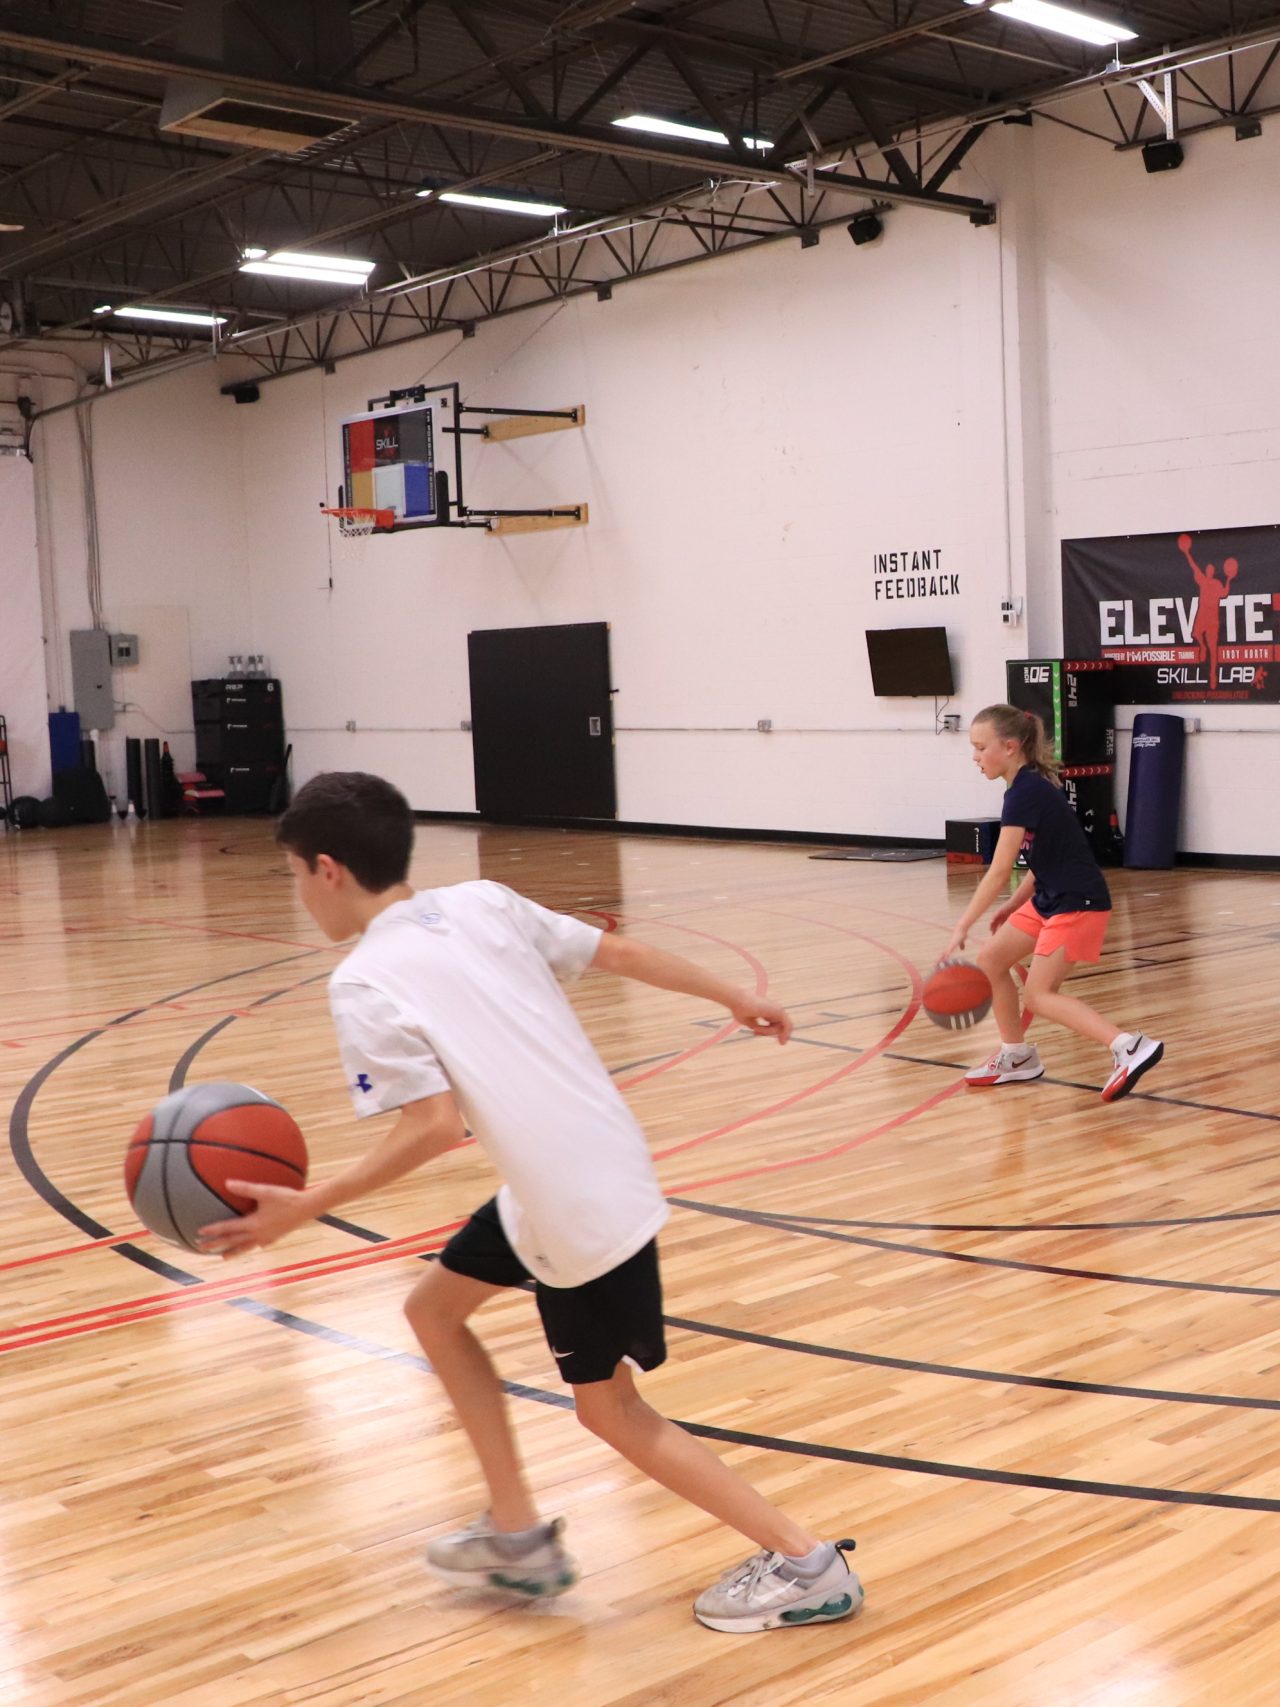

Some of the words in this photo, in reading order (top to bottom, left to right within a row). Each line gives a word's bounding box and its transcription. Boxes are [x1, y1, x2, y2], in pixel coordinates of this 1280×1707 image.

[375, 436, 399, 450] SKILL
[874, 549, 941, 574] INSTANT
[875, 574, 960, 600] FEEDBACK
[1222, 649, 1240, 659] INDY
[1244, 648, 1269, 659] NORTH
[1029, 666, 1050, 683] 30
[1156, 667, 1208, 684] SKILL
[1218, 666, 1256, 683] LAB
[266, 682, 275, 692] 6
